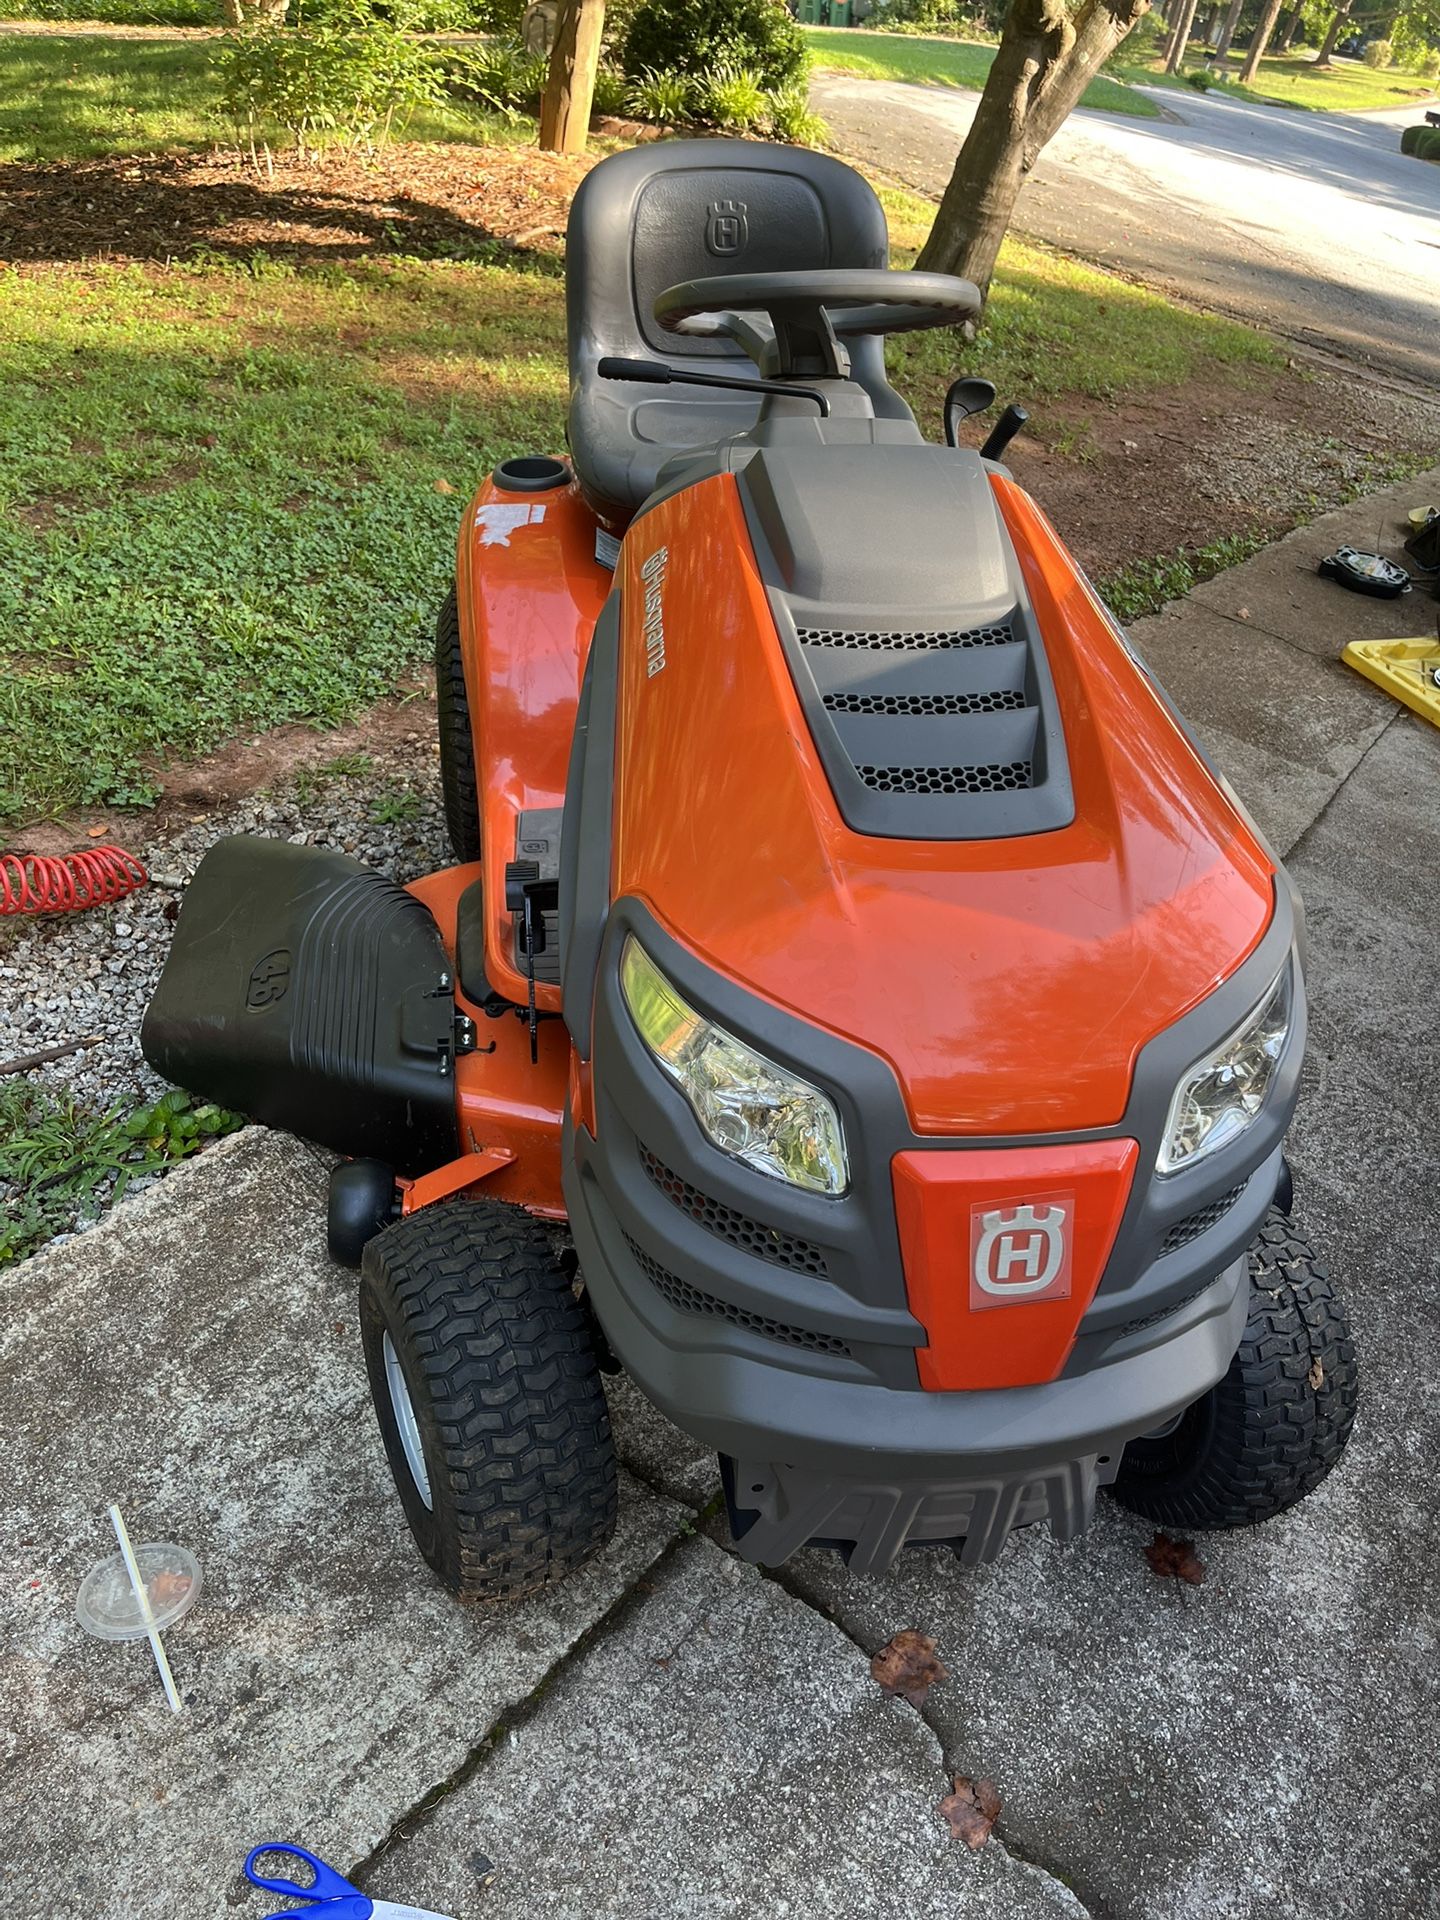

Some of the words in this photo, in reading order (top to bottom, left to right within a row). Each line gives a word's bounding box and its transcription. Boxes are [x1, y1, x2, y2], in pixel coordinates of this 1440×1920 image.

[643, 566, 667, 679] Husqvarna
[251, 958, 290, 1006] 46
[997, 1234, 1043, 1279] H
